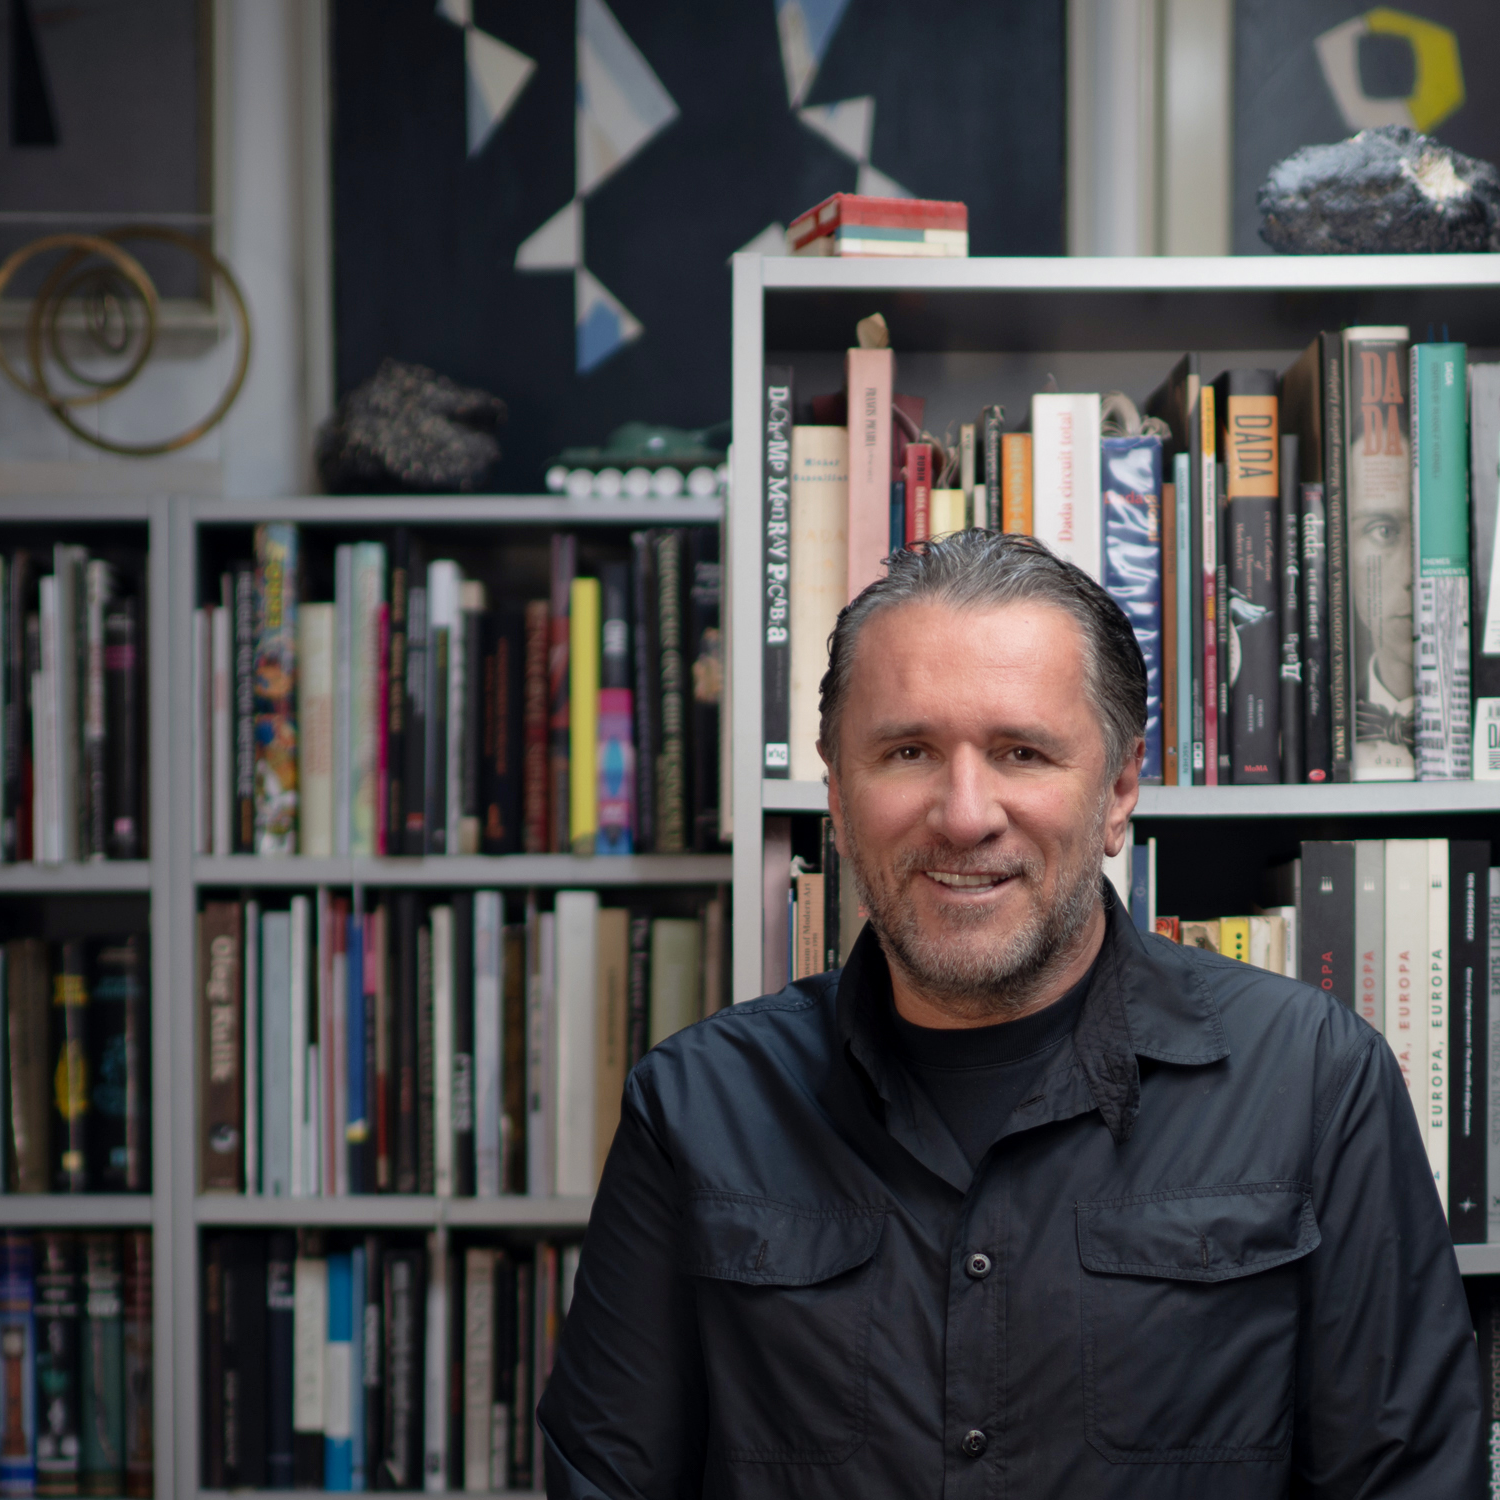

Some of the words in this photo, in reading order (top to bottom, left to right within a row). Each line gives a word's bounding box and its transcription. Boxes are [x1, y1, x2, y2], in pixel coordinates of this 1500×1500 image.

[1329, 358, 1339, 401] Ljubljana
[1360, 351, 1404, 404] DA
[864, 387, 877, 417] FRANCIS
[864, 420, 877, 447] PICABIA
[1058, 412, 1073, 445] total
[1234, 415, 1273, 479] DADA
[1362, 405, 1404, 456] DA
[916, 455, 926, 481] RUBIN
[1058, 452, 1073, 498] circuit
[1331, 446, 1340, 486] Moderna
[1057, 503, 1073, 542] Dada
[1236, 523, 1244, 554] Modern
[1302, 513, 1324, 559] dada
[1236, 556, 1244, 570] Art
[1246, 554, 1254, 586] Museum
[1263, 539, 1273, 581] Collection
[1422, 557, 1451, 566] THEMES
[1422, 567, 1467, 577] MOVEMENTS
[1333, 570, 1342, 650] ZGODOVINSKA
[1281, 633, 1300, 679] Дада
[1334, 654, 1343, 719] SLOVENSKA
[1336, 724, 1344, 759] TANK!
[803, 882, 811, 893] Art
[803, 900, 811, 934] Modern
[205, 935, 237, 1001] Oleg
[1431, 949, 1442, 1027] EUROPA
[1399, 950, 1410, 1030] EUROPA
[210, 1005, 237, 1082] Kulik
[1432, 1041, 1443, 1127] EUROPA,
